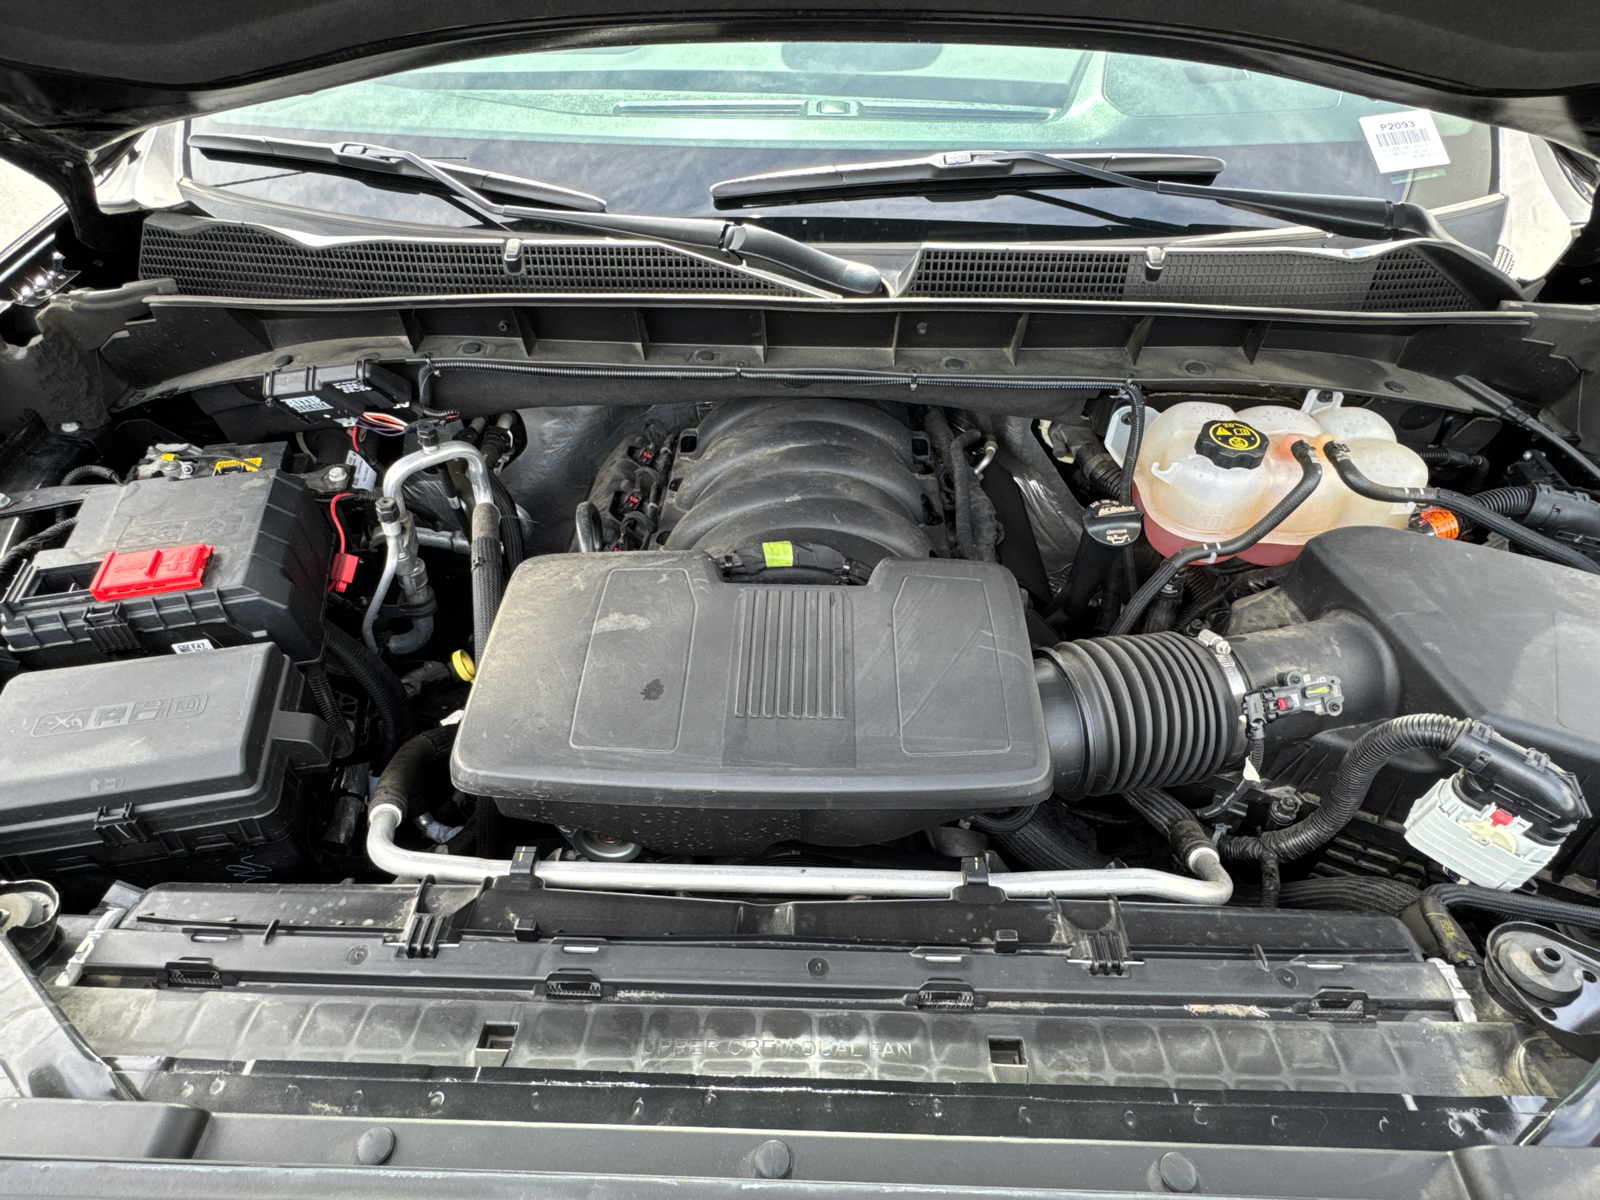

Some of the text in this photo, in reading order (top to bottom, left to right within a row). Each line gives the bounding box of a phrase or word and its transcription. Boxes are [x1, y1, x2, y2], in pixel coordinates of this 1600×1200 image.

[1380, 120, 1415, 131] P2093
[1098, 506, 1135, 516] ACDelco
[641, 1038, 720, 1057] UPPER
[802, 1040, 863, 1057] DUAL
[868, 1041, 912, 1058] FAN
